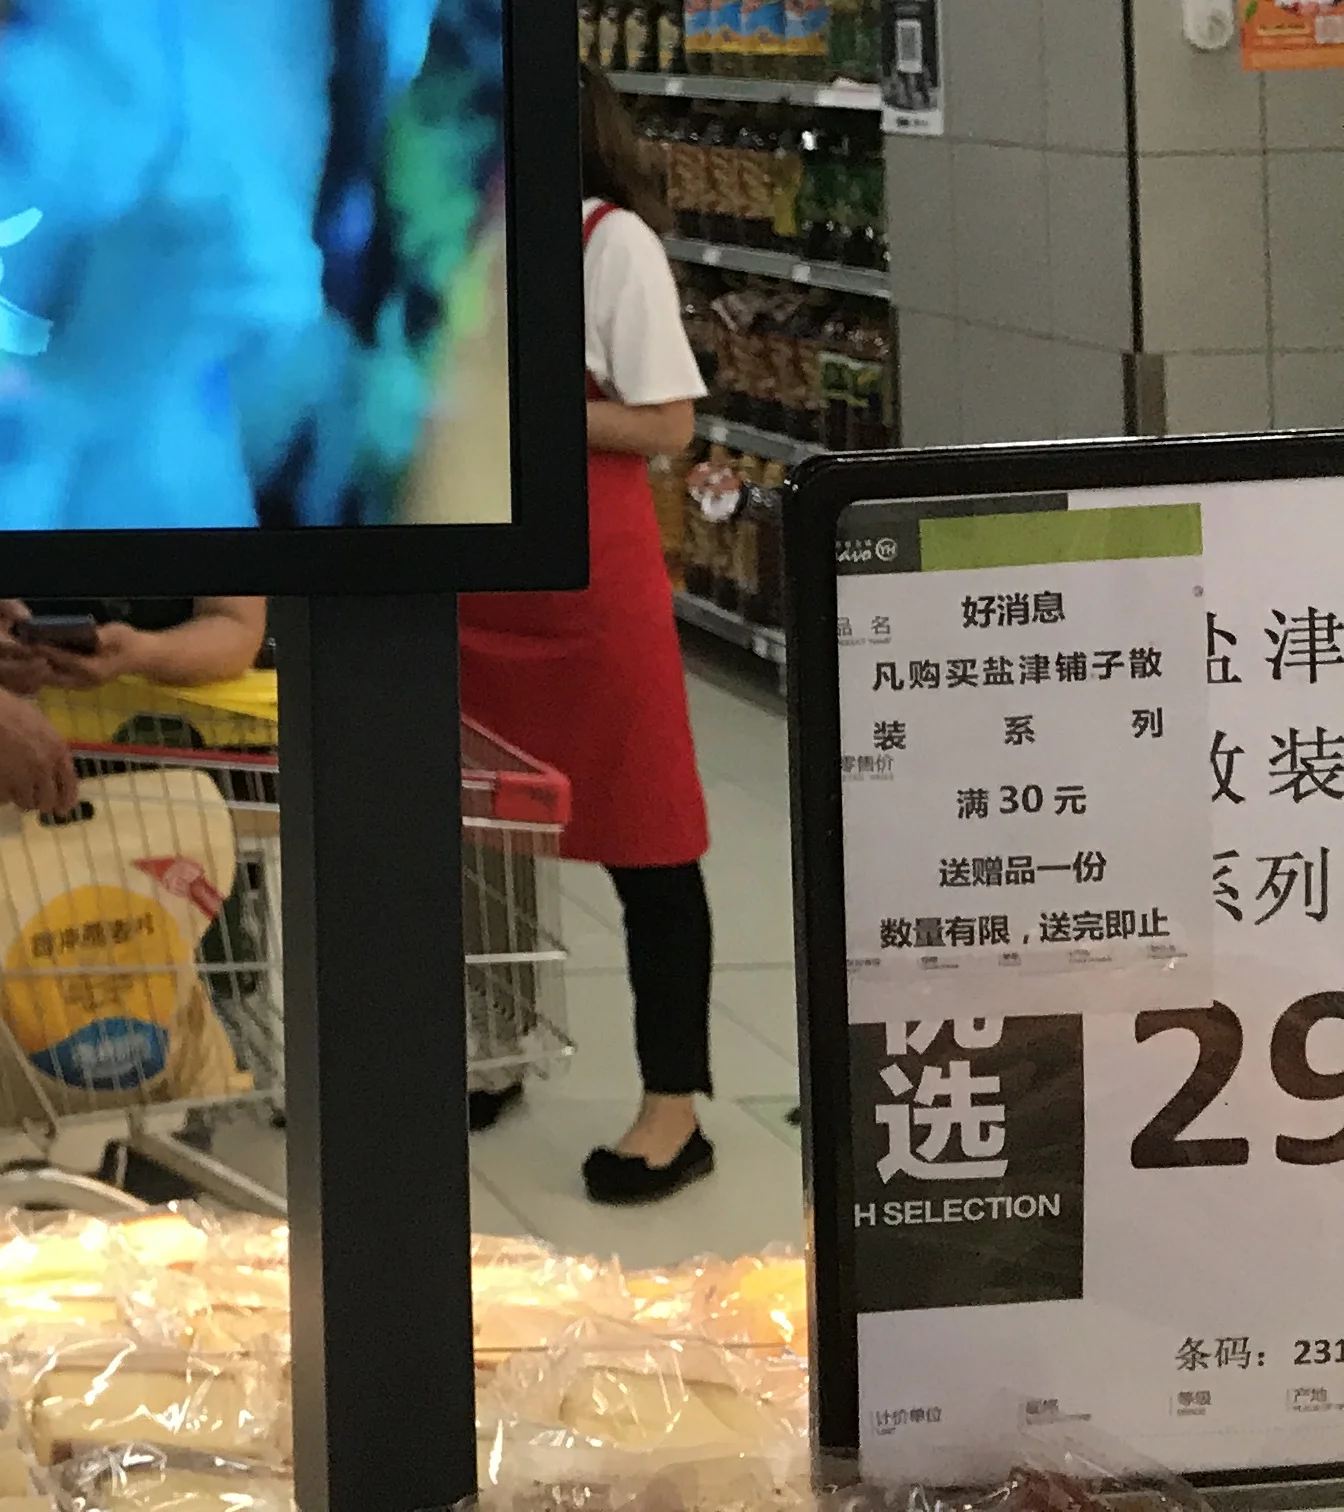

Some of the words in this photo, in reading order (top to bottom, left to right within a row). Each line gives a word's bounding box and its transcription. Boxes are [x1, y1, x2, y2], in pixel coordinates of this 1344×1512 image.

[961, 592, 1066, 629] 好消息
[872, 647, 1163, 693] 凡购买盐津铺子散
[939, 852, 1108, 890] 送赠品一份
[1130, 991, 1344, 1169] 29
[883, 1193, 1061, 1226] SELECTION
